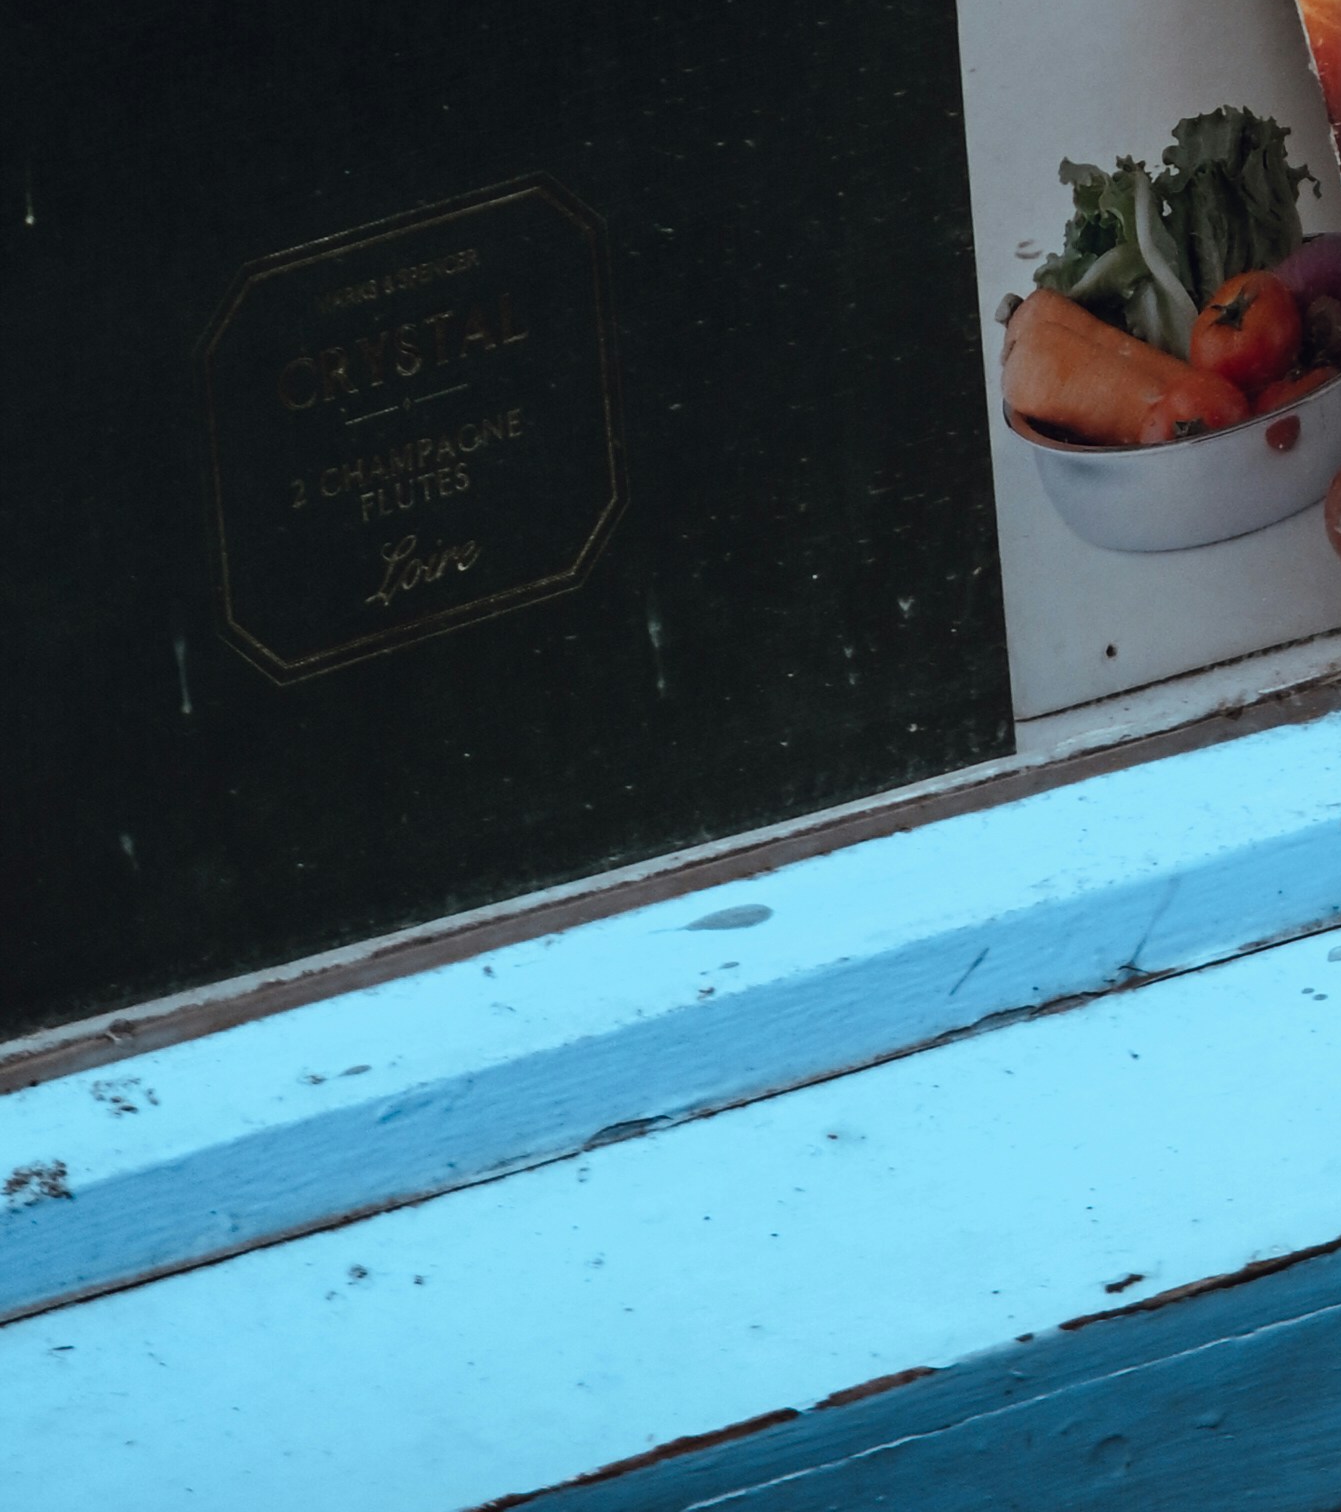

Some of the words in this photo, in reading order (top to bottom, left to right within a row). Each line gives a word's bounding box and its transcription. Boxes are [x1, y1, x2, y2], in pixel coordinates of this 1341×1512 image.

[278, 291, 528, 410] CRYSTAL
[291, 478, 308, 509] 2
[320, 407, 523, 498] CHAMPAGNE
[360, 461, 471, 523] FLUTES
[364, 533, 482, 607] Loire
